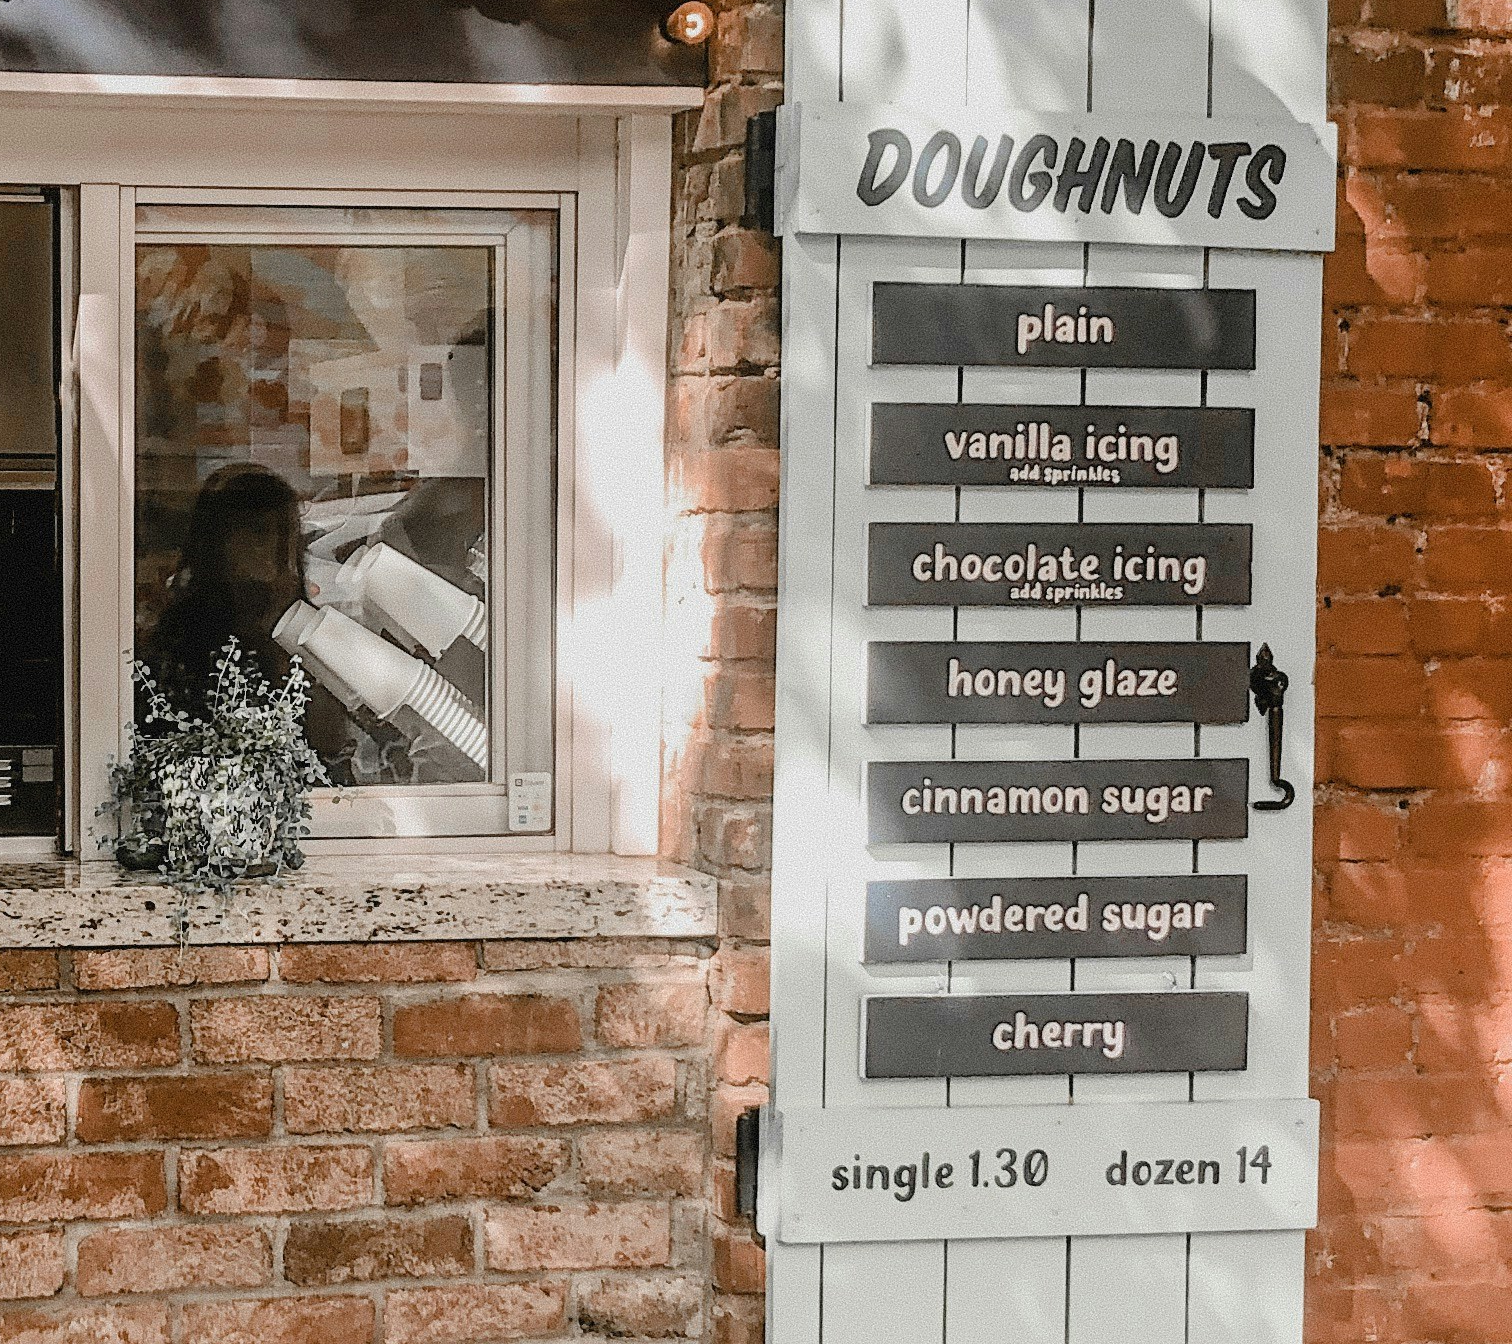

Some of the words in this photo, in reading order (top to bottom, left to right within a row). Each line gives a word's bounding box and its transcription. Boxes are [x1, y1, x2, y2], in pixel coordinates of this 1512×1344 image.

[856, 129, 1287, 220] DOUGHNUTS
[1016, 303, 1115, 354] plain
[944, 423, 1072, 463] vanilla
[1086, 425, 1179, 473] icing
[1009, 465, 1041, 482] add
[1044, 466, 1120, 484] sprinkles
[912, 543, 1100, 583] chocolate
[1113, 546, 1206, 595] icing
[1010, 583, 1042, 601] add
[1045, 583, 1124, 604] sprinkles
[947, 659, 1066, 708] honey
[1079, 660, 1178, 708] glaze
[901, 778, 1089, 815] cinnamon
[1101, 783, 1213, 824] sugar
[898, 893, 1089, 946] powdered
[1102, 901, 1215, 942] sugar
[992, 1012, 1126, 1059] cherry
[832, 1152, 955, 1201] single
[969, 1148, 1049, 1189] 1.30
[1105, 1150, 1220, 1188] dozen
[1235, 1145, 1272, 1185] 14
